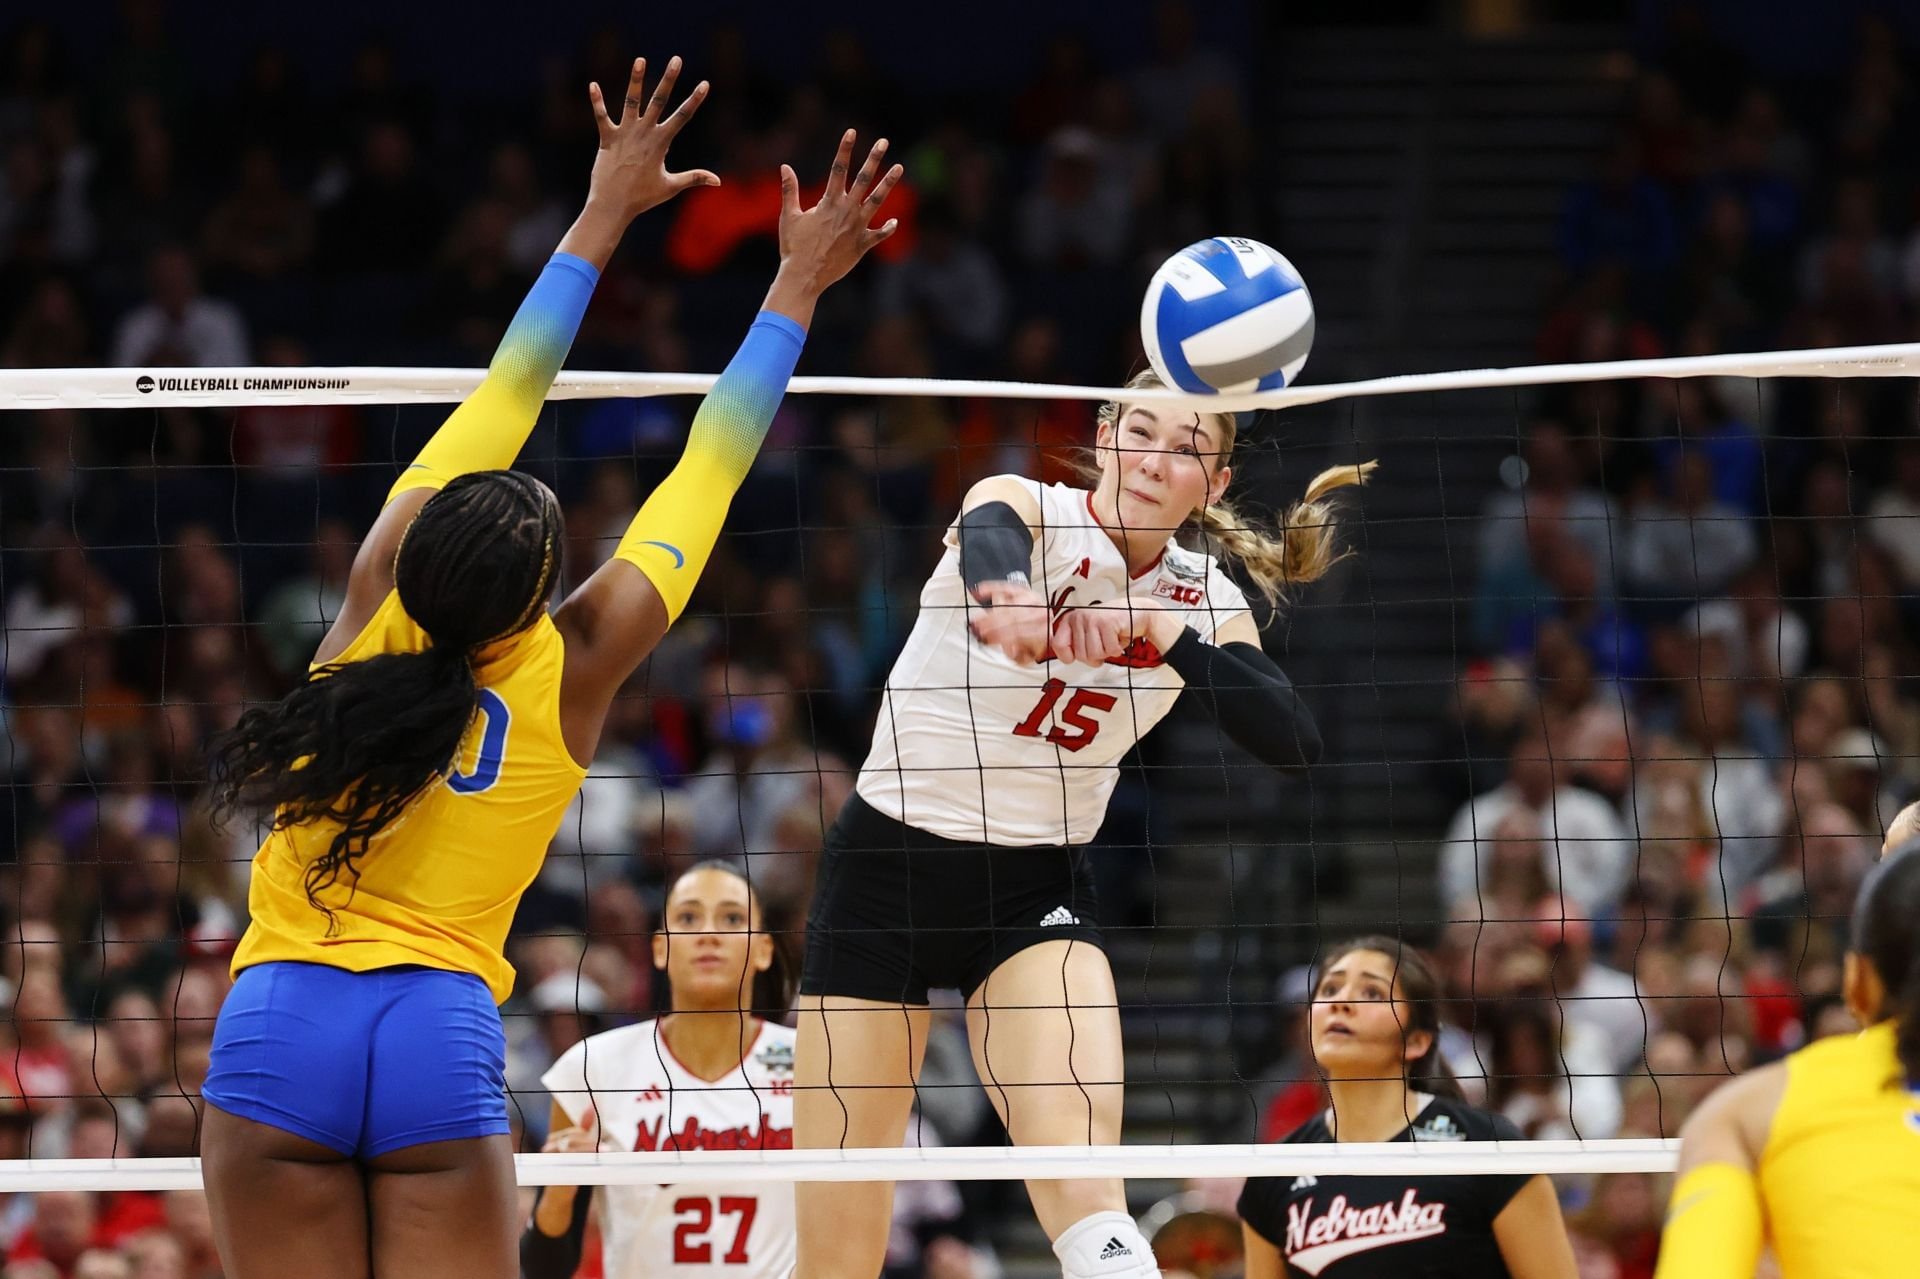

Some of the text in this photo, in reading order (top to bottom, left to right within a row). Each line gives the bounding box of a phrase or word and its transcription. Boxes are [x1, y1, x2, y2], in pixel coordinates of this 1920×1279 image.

[159, 378, 239, 391] VOLLEYBALL
[243, 378, 350, 390] CHAMPIONSHIP
[1012, 678, 1118, 752] 15
[1040, 917, 1080, 927] adidas
[673, 1196, 758, 1264] 27
[1285, 1188, 1445, 1255] Nebraska
[1100, 1248, 1132, 1260] adidas
